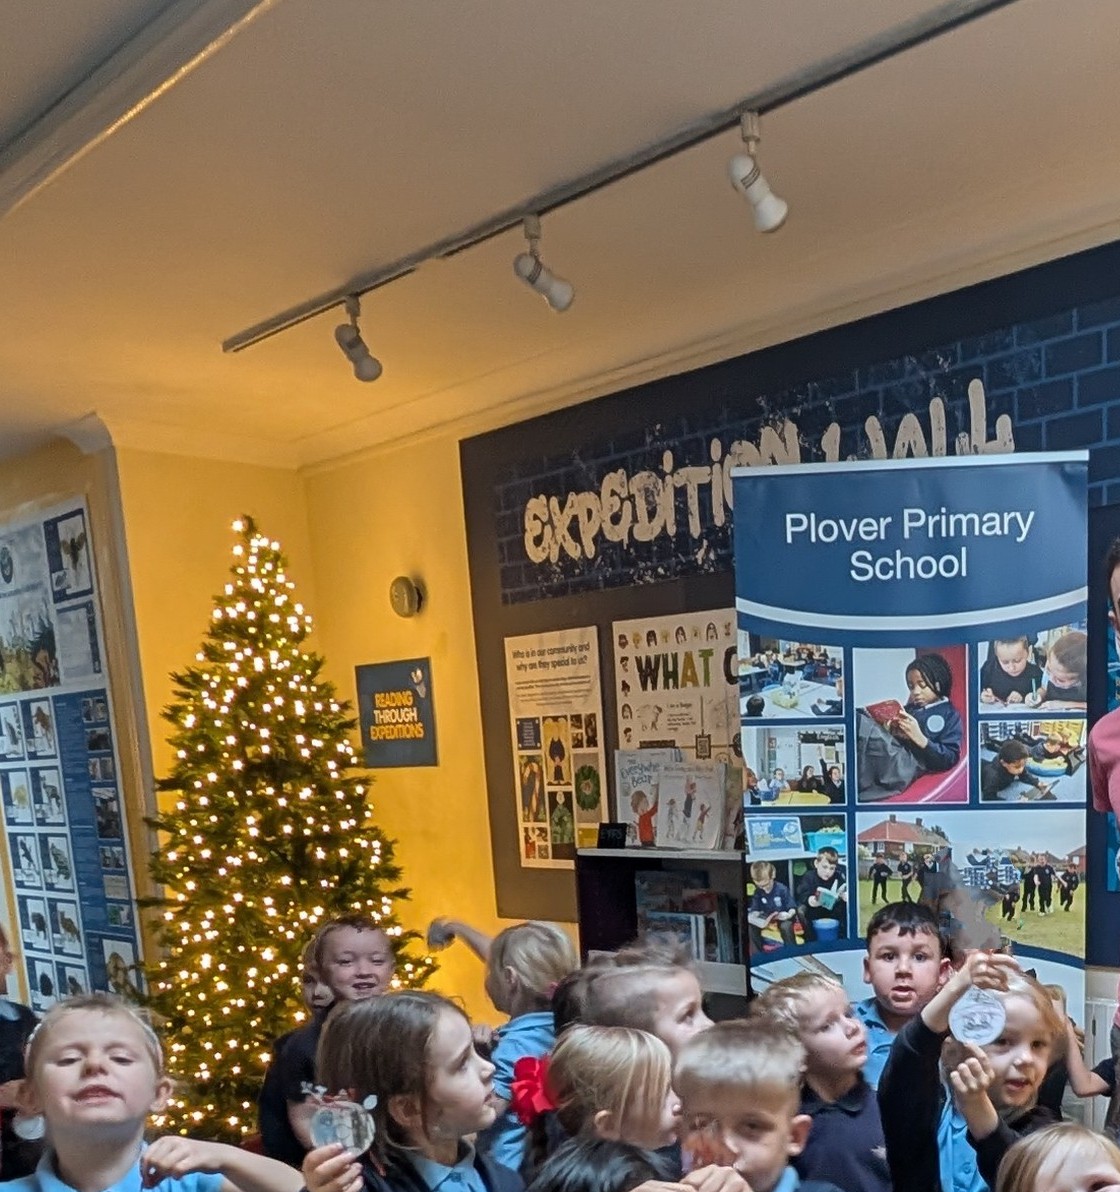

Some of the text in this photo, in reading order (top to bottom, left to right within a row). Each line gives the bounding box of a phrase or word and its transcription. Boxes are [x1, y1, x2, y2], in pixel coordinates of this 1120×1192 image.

[785, 507, 1035, 544] Plover Primary
[850, 547, 967, 581] School
[635, 648, 714, 691] WHAT
[374, 690, 413, 708] READING
[373, 707, 418, 724] THROUGH
[370, 723, 424, 740] EXPEDITIONS
